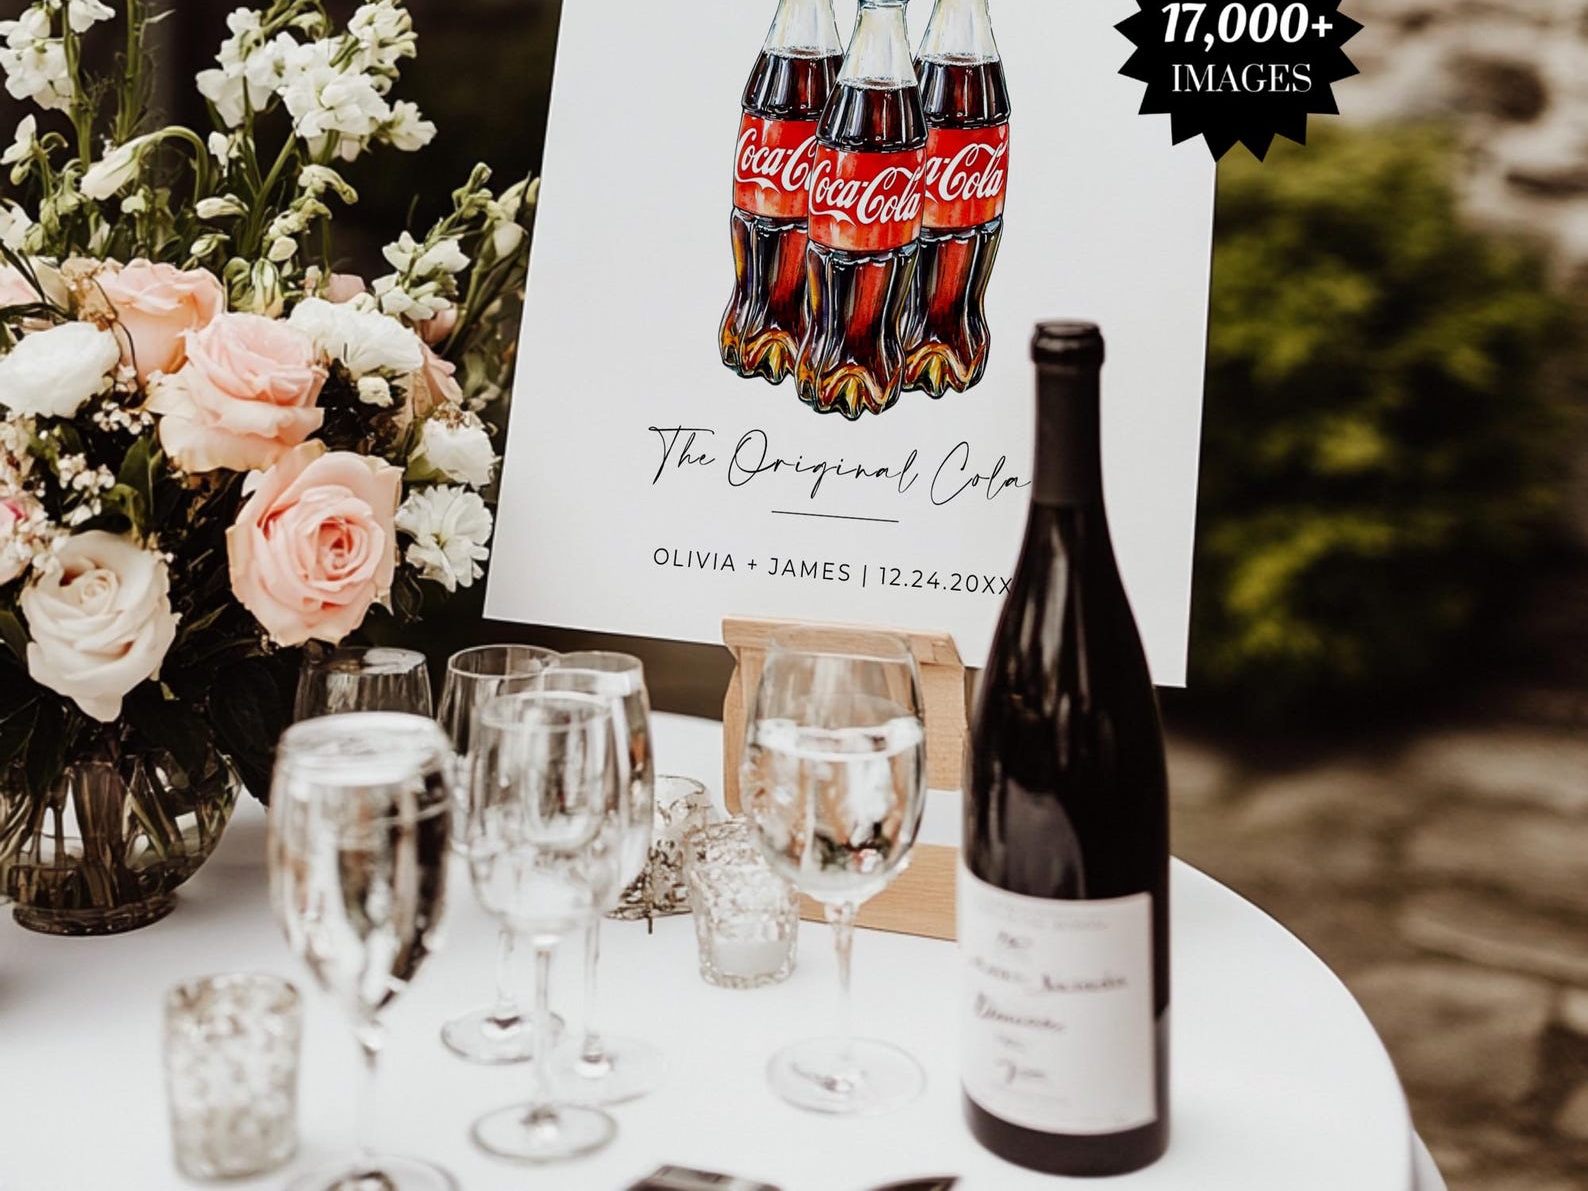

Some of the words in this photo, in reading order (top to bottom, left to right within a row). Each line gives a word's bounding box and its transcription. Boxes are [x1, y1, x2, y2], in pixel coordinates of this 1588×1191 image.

[734, 127, 817, 194] Coca-C
[808, 156, 927, 227] Coca-Cola
[926, 140, 1009, 204] a-Cola
[648, 424, 717, 486] The
[727, 428, 919, 500] Original
[930, 440, 1033, 507] Cola
[653, 547, 737, 573] OLIVIA
[747, 558, 758, 570] +
[768, 557, 851, 582] JAMES
[879, 566, 1013, 595] 12.24.20XX
